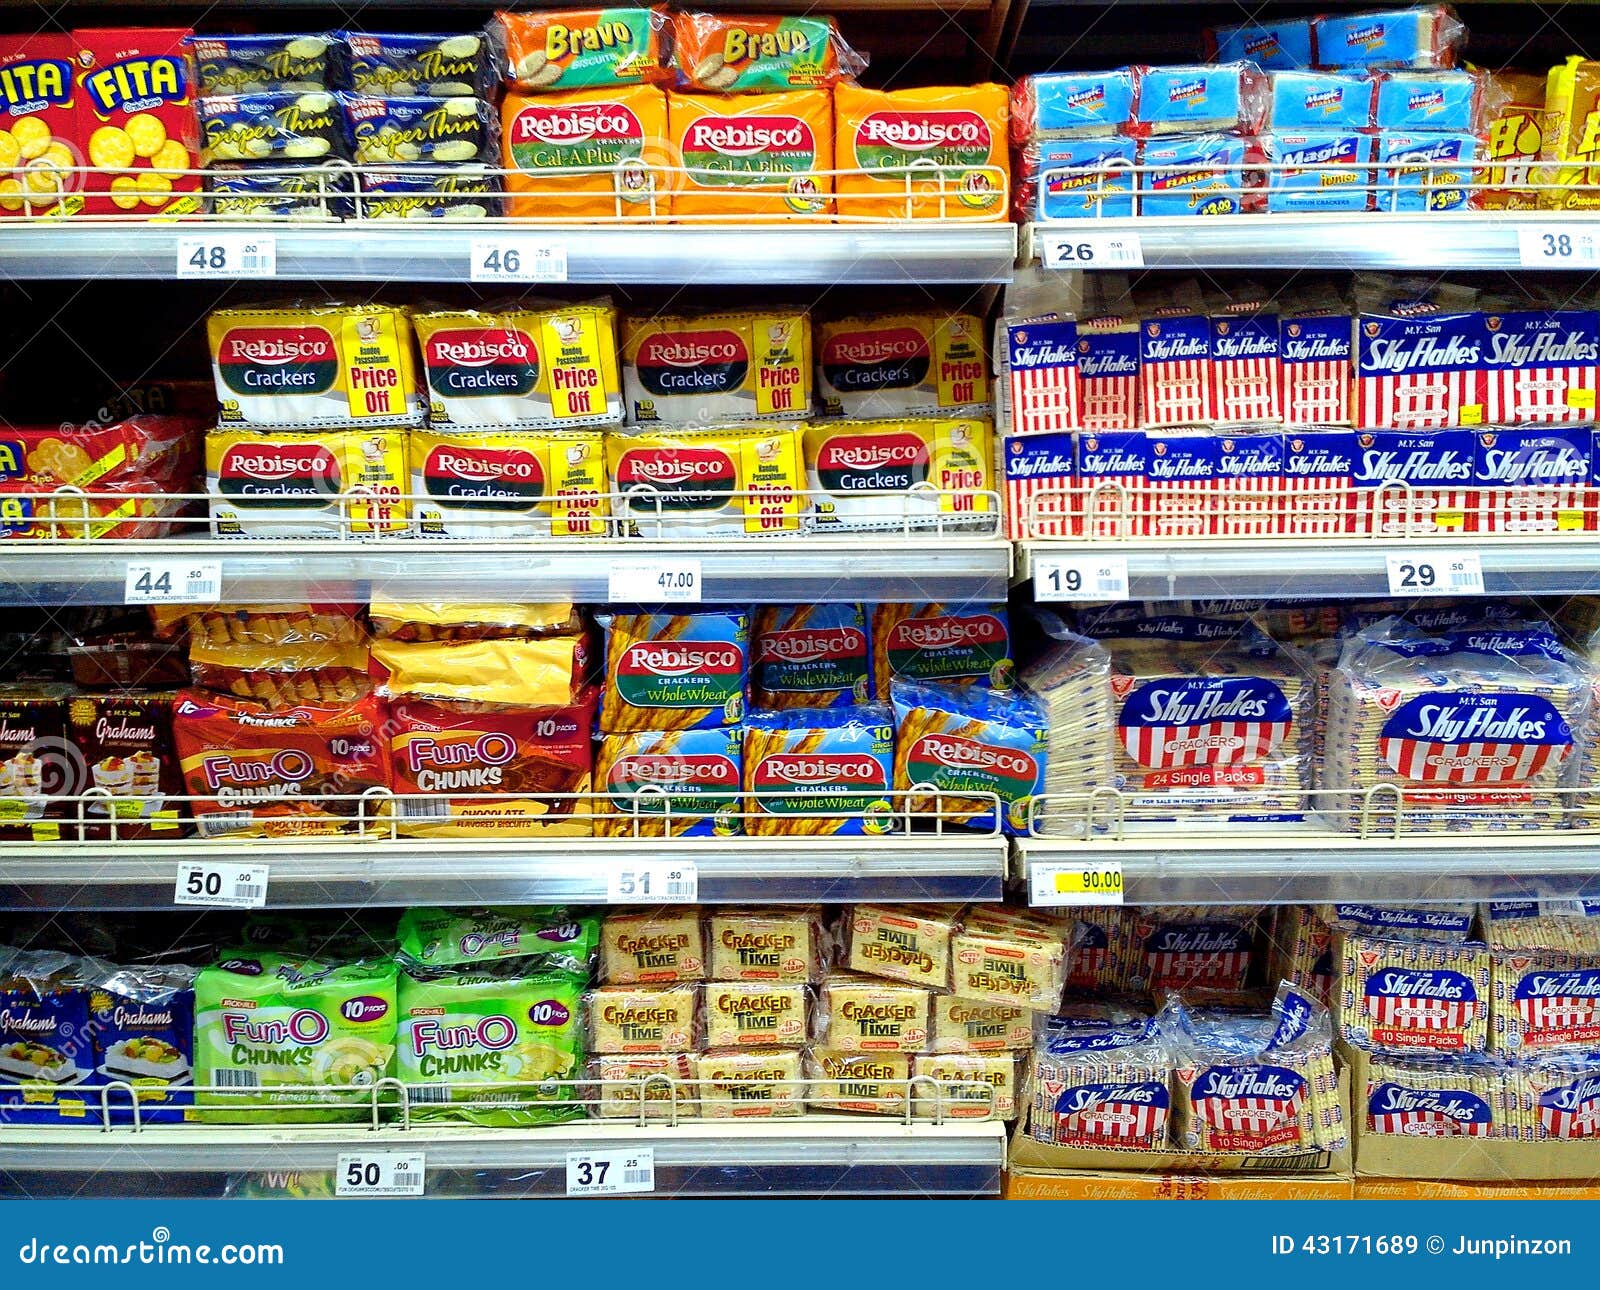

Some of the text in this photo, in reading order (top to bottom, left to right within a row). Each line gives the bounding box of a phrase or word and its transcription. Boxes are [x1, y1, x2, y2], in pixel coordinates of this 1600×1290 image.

[546, 23, 632, 60] Bravo
[724, 28, 807, 64] Bravo
[266, 51, 325, 79] Thin
[351, 50, 478, 95] Super Thin
[0, 63, 62, 103] ITA
[92, 59, 178, 109] FITA
[206, 104, 334, 155] Super Thin
[355, 108, 480, 158] Super Thin
[520, 113, 629, 144] Rebisco
[867, 120, 978, 150] Rebisco
[693, 125, 802, 155] Rebisco
[534, 148, 621, 168] Cal-A Plus
[1282, 139, 1358, 165] Magic
[1057, 243, 1094, 261] 26
[1542, 234, 1572, 256] 38
[189, 246, 226, 269] 48
[483, 250, 521, 272] 46
[1405, 325, 1441, 334] M.Y. San
[1525, 320, 1560, 330] M.Y. San
[232, 339, 328, 365] Rebisco
[436, 342, 528, 366] Rebisco
[650, 343, 738, 367] Rebisco
[835, 340, 918, 364] Rebisco
[1144, 338, 1209, 359] SkyFlakes
[1213, 335, 1278, 357] SkyFlakes
[1283, 338, 1350, 359] SkyFlakes
[1361, 337, 1480, 371] SkyFlakes
[1484, 332, 1598, 366] SkyFlakes
[244, 370, 315, 386] Crackers
[352, 367, 397, 388] Price
[449, 371, 518, 388] Crackers
[554, 368, 597, 389] Price
[660, 372, 727, 389] Crackers
[760, 368, 799, 388] Price
[845, 368, 909, 384] Crackers
[942, 362, 981, 382] Price
[365, 391, 390, 414] Off
[567, 391, 590, 413] Off
[772, 389, 792, 409] Off
[952, 382, 975, 402] Off
[1418, 439, 1434, 447] San
[231, 456, 328, 480] Rebisco
[439, 454, 533, 481] Rebisco
[830, 445, 919, 469] Rebisco
[1008, 457, 1073, 475] SkyFlakes
[1081, 453, 1145, 473] SkyFlakes
[1149, 457, 1213, 477] SkyFlakes
[1285, 454, 1351, 473] SkyFlakes
[1354, 451, 1472, 482] SkyFlakes
[1476, 450, 1589, 482] SkyFlakes
[630, 460, 724, 483] Rebisco
[841, 475, 907, 489] Crackers
[942, 470, 983, 489] Price
[135, 571, 172, 594] 44
[658, 572, 694, 587] 47.00
[1048, 568, 1082, 591] 19
[1399, 563, 1464, 586] 29 .50
[899, 622, 993, 649] Rebisco
[760, 635, 858, 661] Rebisco
[630, 649, 736, 676] Rebisco
[1142, 689, 1267, 725] SkyFlakes
[1459, 697, 1497, 705] M.Y. San
[95, 718, 155, 741] Grahams
[537, 720, 576, 736] 10 PACKS
[1408, 705, 1545, 740] SkyFlakes
[874, 728, 892, 740] 10
[1170, 738, 1236, 750] CRACKERS
[331, 740, 348, 754] 10
[922, 740, 1028, 774] Rebisco
[621, 762, 728, 782] Rebisco
[766, 760, 872, 783] Rebisco
[1434, 756, 1509, 767] CRACKERS
[417, 768, 502, 791] CHUNKS
[1152, 771, 1255, 785] 24 Single Packs
[217, 784, 301, 808] CHUNKS
[456, 820, 531, 828] FLAVORED BISCUITS
[186, 871, 251, 895] 50 .00
[619, 872, 650, 894] 51
[1083, 871, 1121, 888] 90.00
[618, 934, 689, 953] CRACKER
[721, 930, 795, 951] CRACKER
[862, 944, 935, 973] CRACKER
[1379, 973, 1463, 998] SkyFlakes
[345, 1001, 362, 1018] 10
[534, 1003, 550, 1020] 10
[718, 994, 791, 1014] CRACKER
[842, 1002, 915, 1021] CRACKER
[948, 1006, 1022, 1023] CRACKER
[1398, 1008, 1443, 1016] CRACKERS
[1545, 1006, 1588, 1014] CRACKERS
[2, 1008, 56, 1031] Grahams
[114, 1005, 172, 1028] Grahams
[604, 1006, 678, 1025] CRACKER
[1381, 1032, 1457, 1046] 10 Single Packs
[1533, 1030, 1598, 1044] 10 Single Packs
[231, 1045, 312, 1067] CHUNKS
[420, 1052, 502, 1077] CHUNKS
[1204, 1073, 1294, 1097] SkyFlakes
[1085, 1112, 1132, 1122] CRACKERS
[1229, 1110, 1277, 1119] CRACKERS
[1218, 1131, 1293, 1149] 10 Single Packs
[347, 1162, 408, 1186] 50 .00
[577, 1159, 638, 1185] 37 .25
